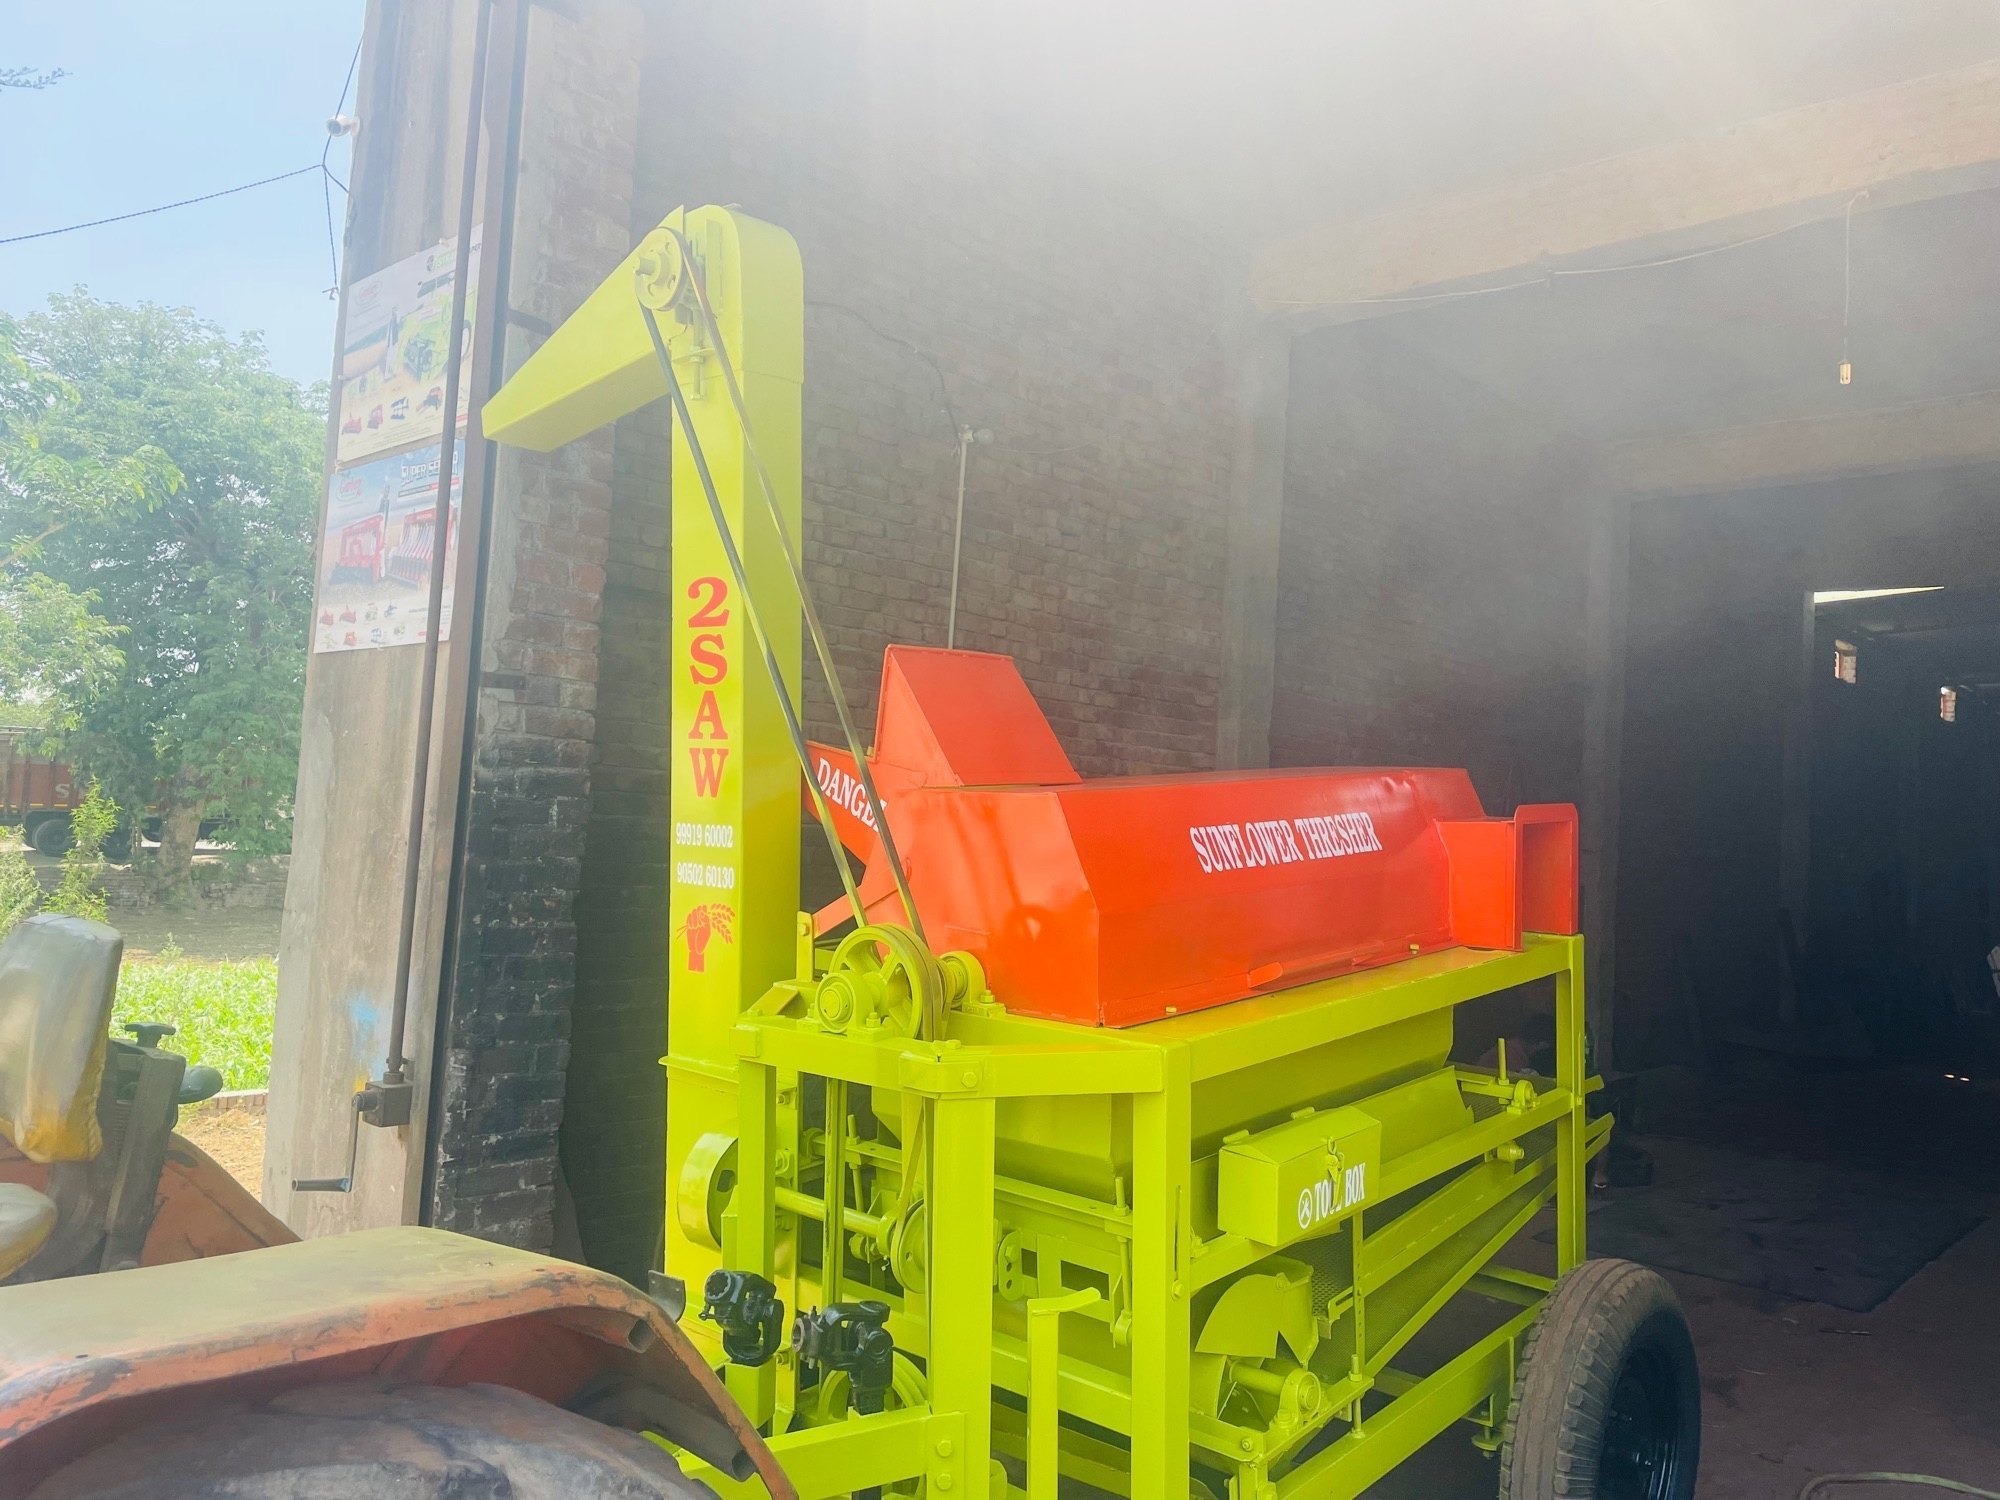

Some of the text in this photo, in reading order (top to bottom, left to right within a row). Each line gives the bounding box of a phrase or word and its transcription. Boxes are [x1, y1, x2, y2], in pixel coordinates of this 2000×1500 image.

[687, 576, 730, 798] 2SAW
[1189, 812, 1383, 874] SUNFLOWER THRESHER
[1345, 1162, 1366, 1208] BOX
